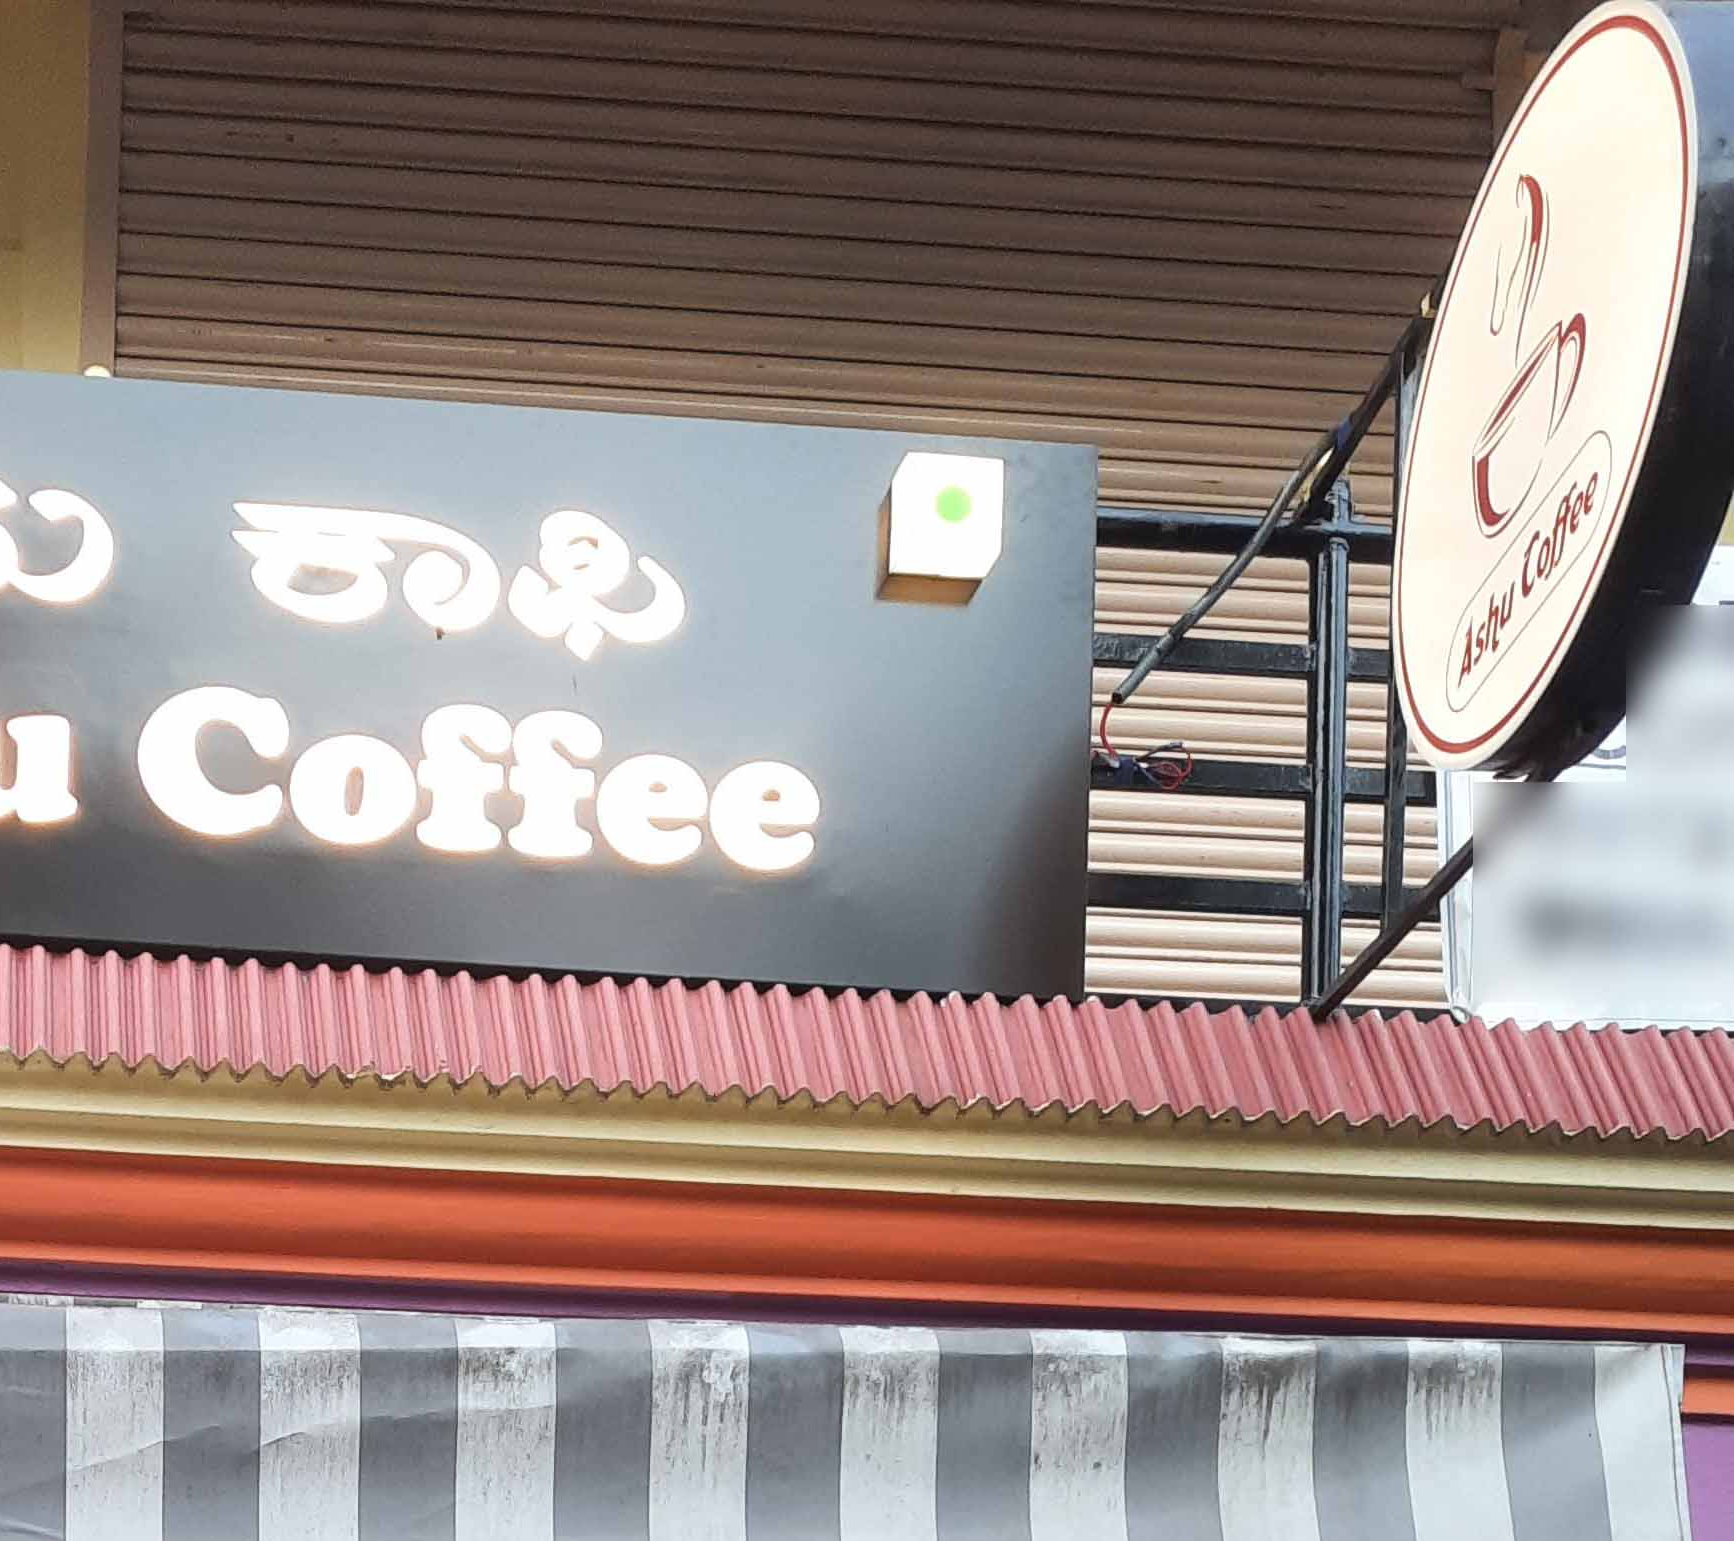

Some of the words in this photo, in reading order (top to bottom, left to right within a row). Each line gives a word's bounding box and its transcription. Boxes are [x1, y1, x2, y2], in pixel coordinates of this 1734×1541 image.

[230, 500, 687, 662] ಕಾಫಿ
[1457, 580, 1516, 690] Ashu
[1521, 471, 1599, 598] Coffee
[137, 684, 823, 872] Coffee
